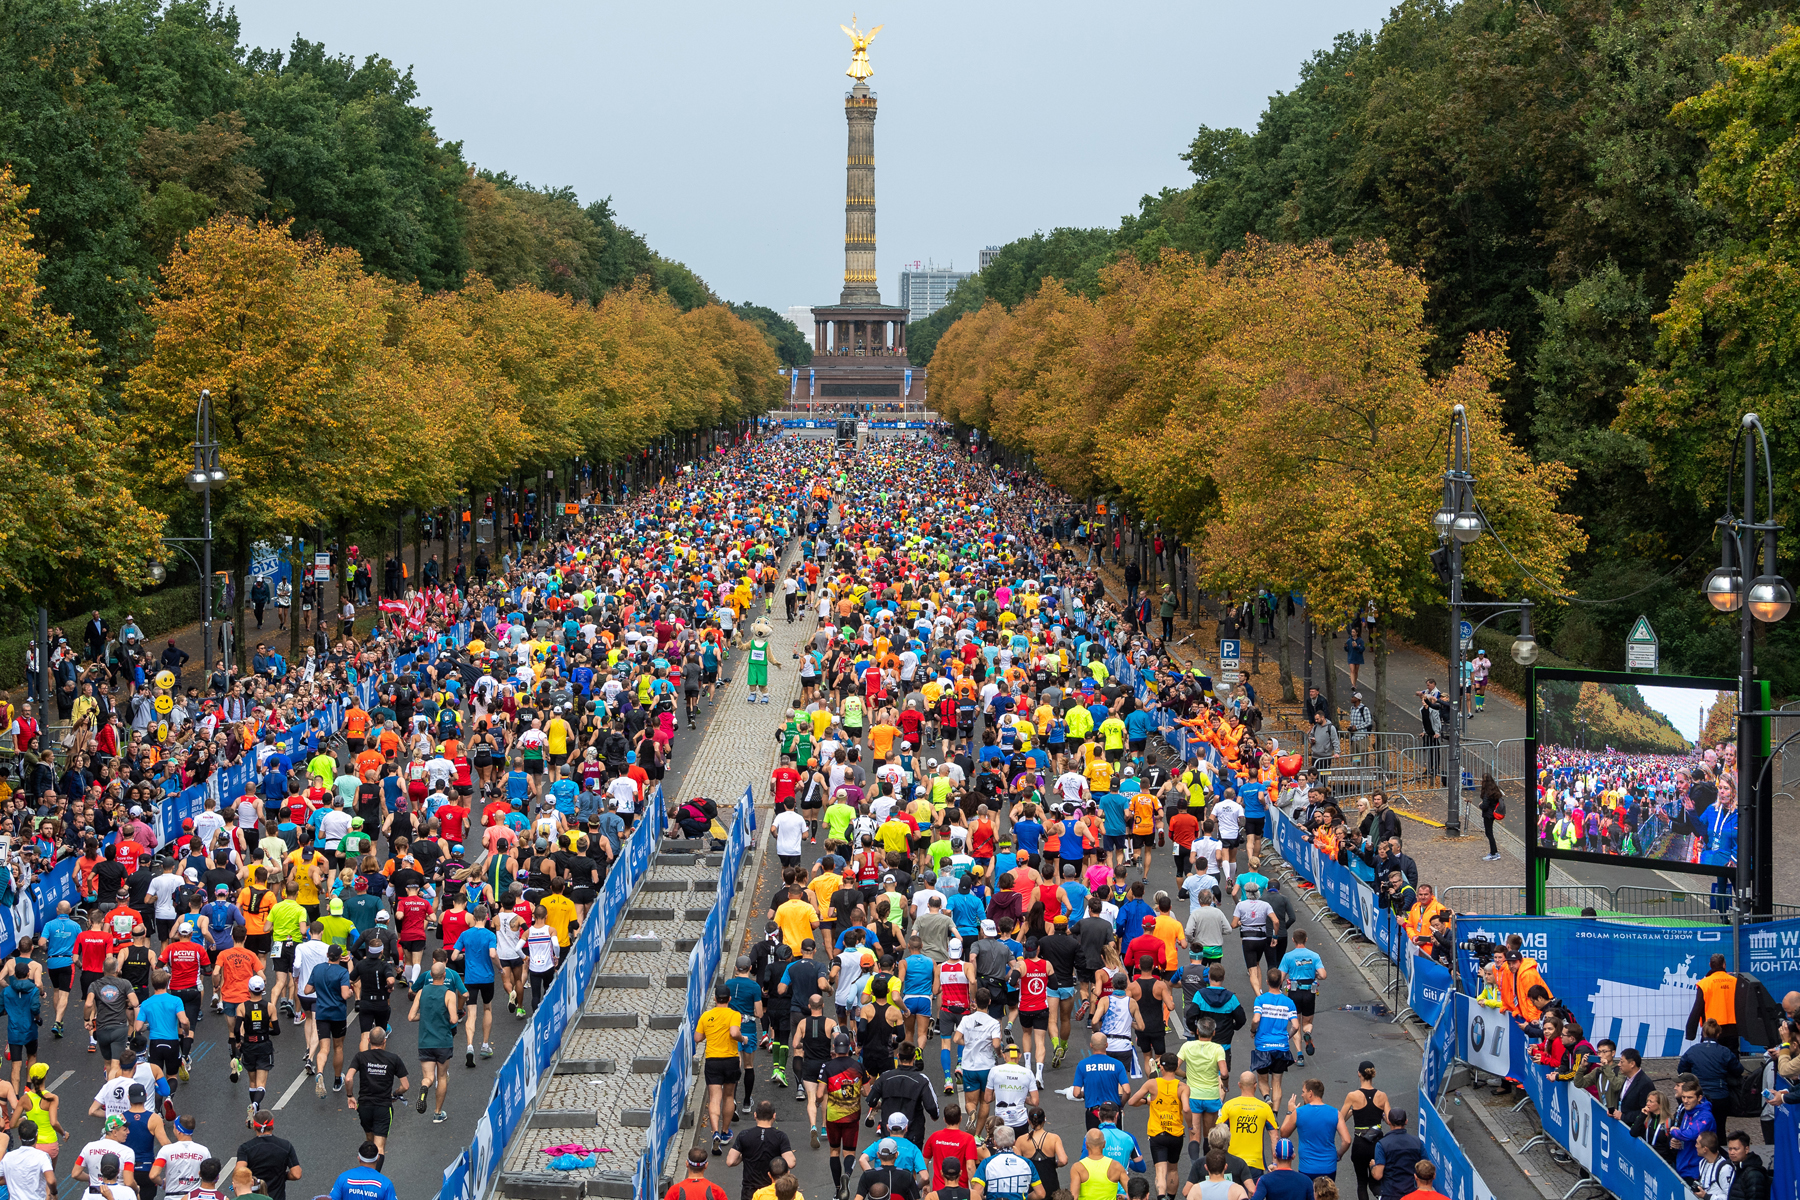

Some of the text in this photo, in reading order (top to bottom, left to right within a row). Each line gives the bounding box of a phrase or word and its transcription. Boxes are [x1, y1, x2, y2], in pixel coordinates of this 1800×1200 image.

[1224, 642, 1234, 656] P
[1151, 772, 1159, 786] 7
[1423, 988, 1437, 1001] Giti
[1086, 1064, 1097, 1072] B2
[1237, 1115, 1258, 1124] crivit
[1550, 1109, 1562, 1127] adidas
[1236, 1123, 1258, 1133] PRO
[90, 1149, 121, 1158] FINISR
[170, 1152, 203, 1161] FINISHER
[364, 1190, 378, 1198] VIDA
